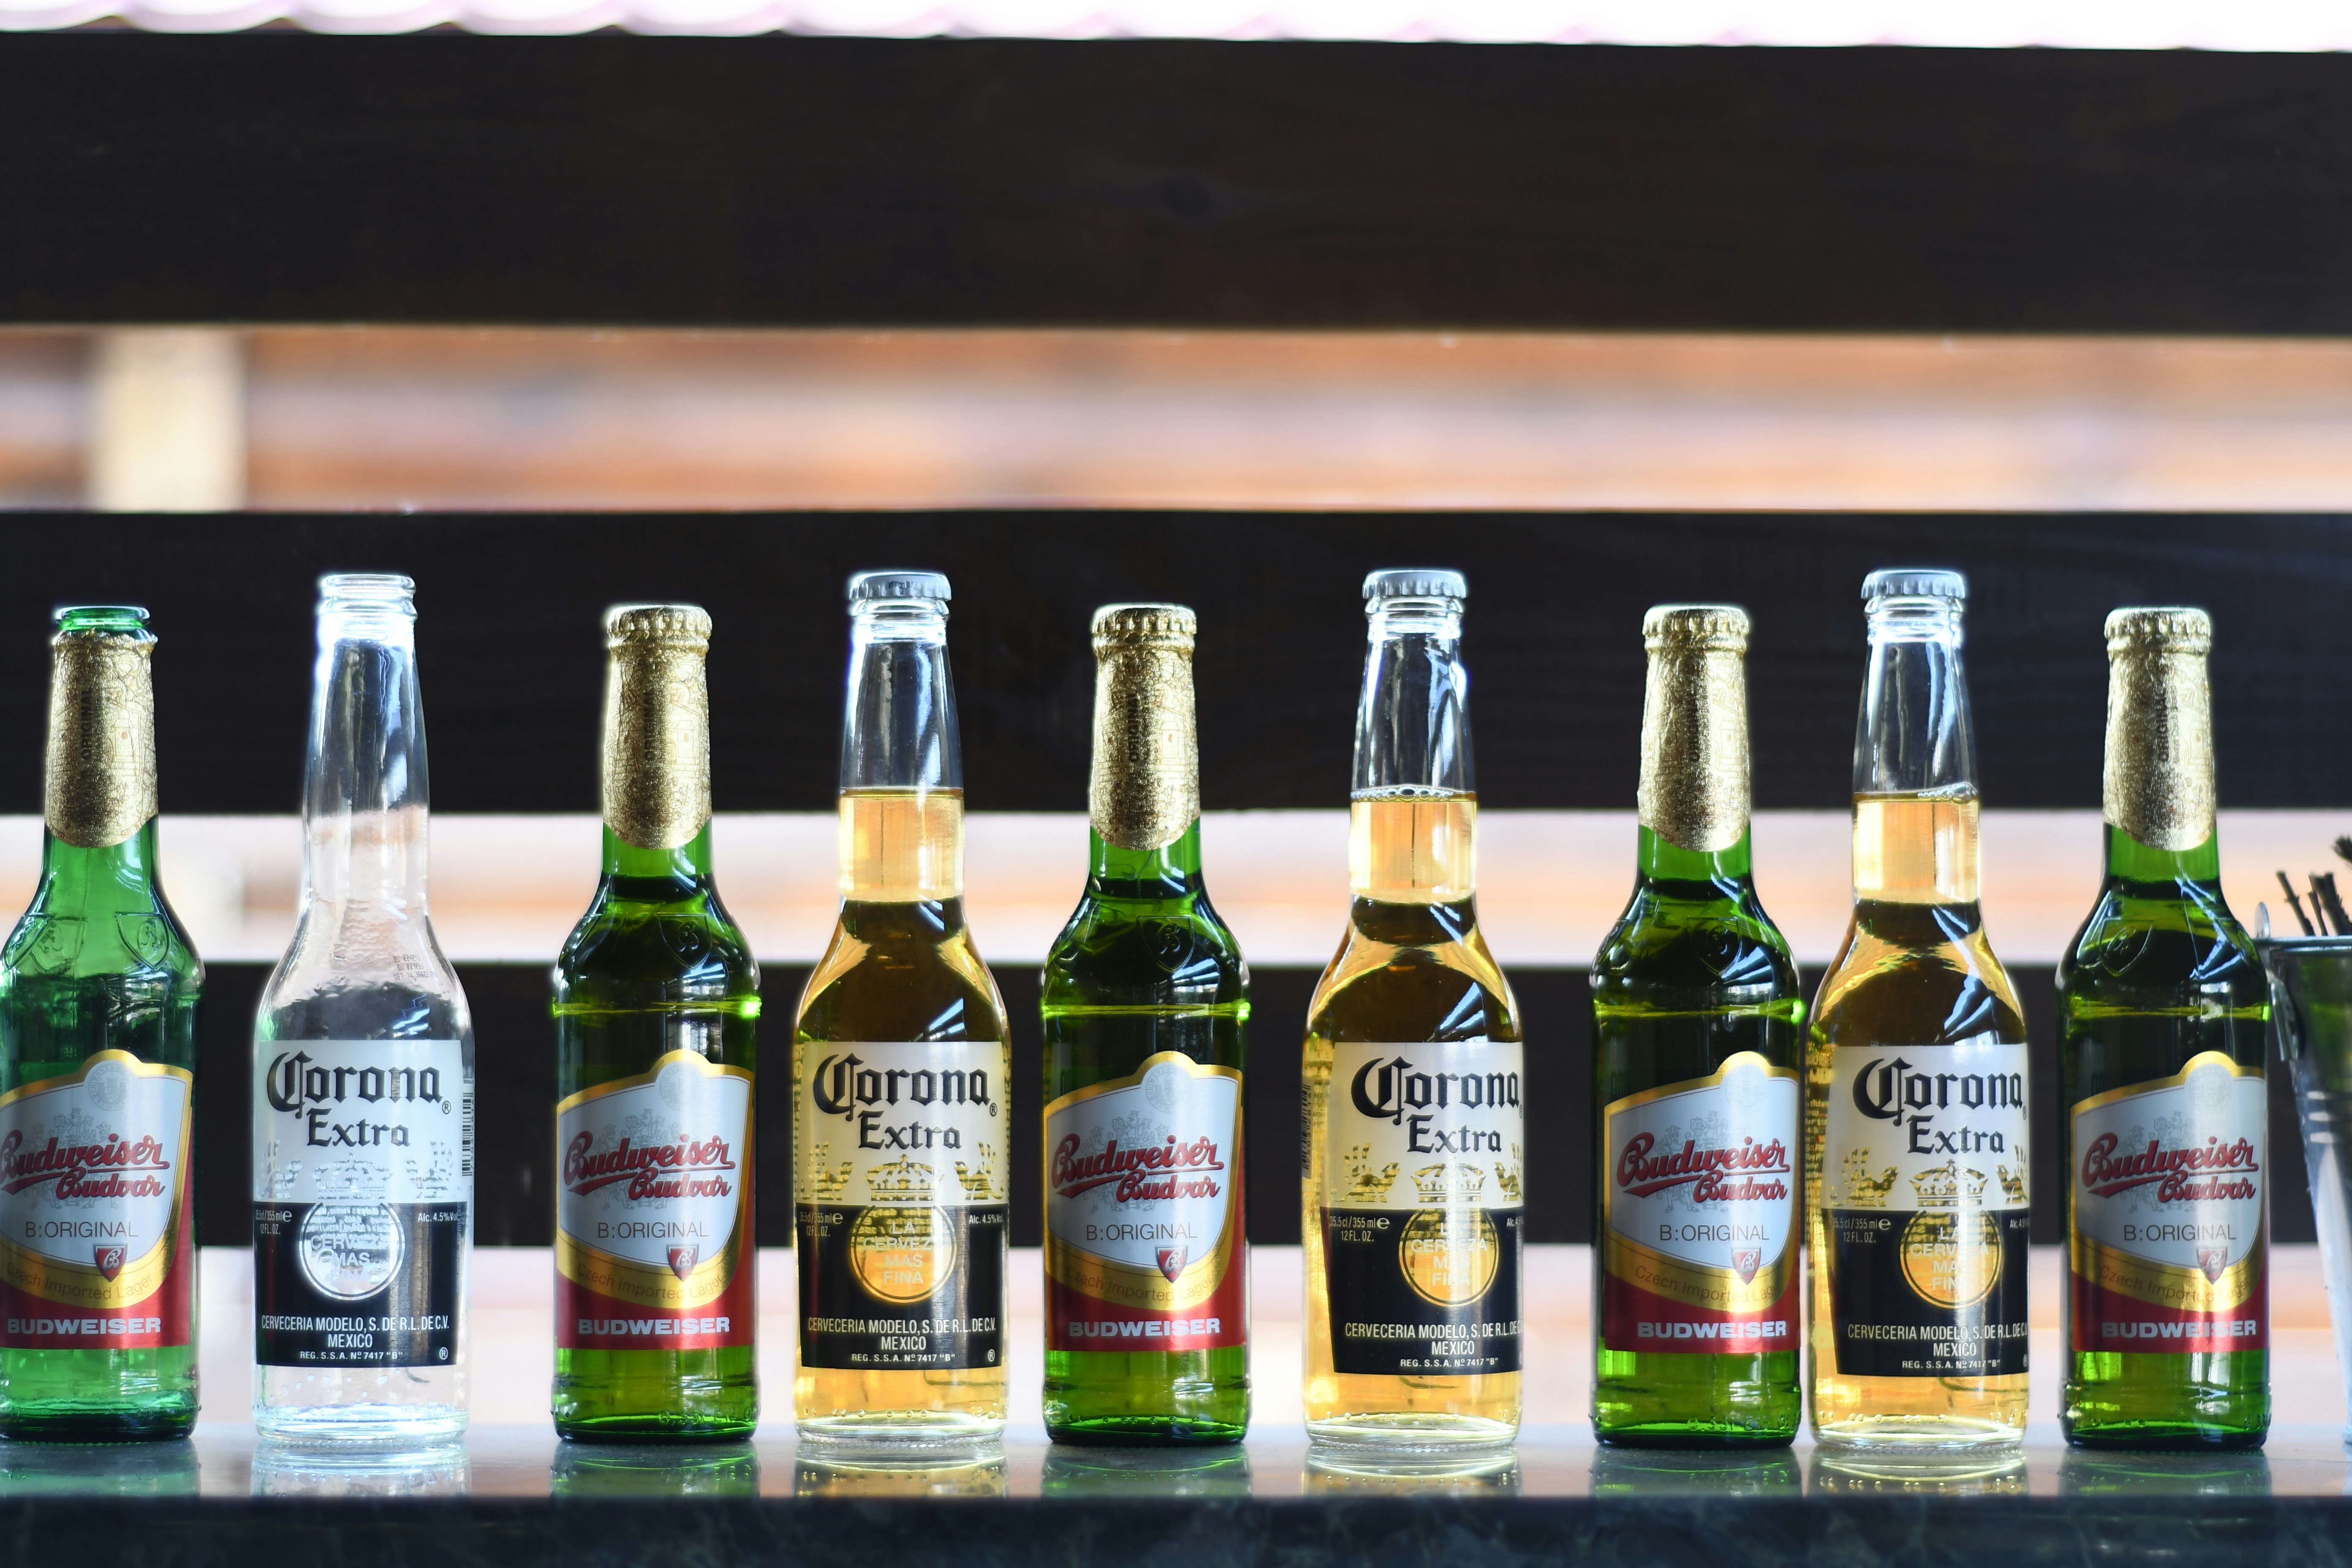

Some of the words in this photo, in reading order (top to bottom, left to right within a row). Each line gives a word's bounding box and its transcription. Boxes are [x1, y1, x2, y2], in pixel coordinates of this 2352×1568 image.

[82, 686, 92, 760] ORIGINAL
[267, 1051, 443, 1119] Corona
[813, 1053, 991, 1122] Corona
[1351, 1056, 1519, 1125] Corona
[1853, 1057, 2023, 1127] Corona
[307, 1108, 411, 1146] Extra
[858, 1111, 962, 1149] Extra
[1407, 1114, 1502, 1153] Extra
[1907, 1115, 2004, 1154] Extra
[0, 1130, 170, 1180] Budweiser
[564, 1130, 735, 1185] Budweiser
[1052, 1133, 1224, 1187] Budweiser
[1617, 1132, 1790, 1187] Budweiser
[2082, 1133, 2259, 1187] Budweiser
[56, 1168, 166, 1200] Budvar
[629, 1168, 732, 1198] Budvar
[1117, 1169, 1221, 1203] Budvar
[1694, 1170, 1788, 1203] Budvar
[2158, 1170, 2256, 1203] Budvar
[418, 1213, 432, 1222] Alc.
[969, 1215, 981, 1224] Alc.
[1507, 1218, 1515, 1227] Alc.
[272, 1224, 280, 1234] OZ.
[821, 1226, 830, 1237] OZ.
[893, 1222, 915, 1234] LA
[1362, 1230, 1374, 1241] OZ.
[863, 1237, 944, 1250] CERVEZ
[1411, 1239, 1486, 1252] CERVEZA
[1865, 1232, 1876, 1243] OZ.
[332, 1252, 370, 1265] MAS
[885, 1255, 923, 1267] MAS
[1434, 1256, 1469, 1269] MAS
[8, 1262, 41, 1286] Czech
[45, 1277, 112, 1299] Imported
[117, 1274, 152, 1298] Lager
[331, 1269, 370, 1282] FINA
[578, 1263, 614, 1287] Czech
[619, 1278, 683, 1299] Imported
[690, 1274, 722, 1298] Lager
[884, 1271, 923, 1284] FINA
[1433, 1273, 1470, 1285] FINA
[1636, 1266, 1677, 1291] Czech
[1682, 1281, 1748, 1302] Imported
[1753, 1282, 1778, 1301] Lage
[2100, 1266, 2142, 1290] Czech
[1108, 1280, 1173, 1301] Imported
[8, 1318, 161, 1335] BUDWEISER
[262, 1315, 313, 1331] CERVECERIA
[316, 1317, 367, 1333] MODELO,
[369, 1317, 380, 1331] S.
[382, 1317, 396, 1331] DE
[400, 1317, 419, 1330] R.L.
[422, 1316, 433, 1330] DE
[436, 1315, 449, 1329] C.V.
[579, 1317, 730, 1335] BUDWEISER
[808, 1317, 866, 1333] CERVECERIA
[868, 1320, 920, 1336] MODELO,
[922, 1320, 933, 1334] S.
[936, 1320, 950, 1333] DE
[953, 1319, 971, 1332] R.L.
[972, 1318, 983, 1331] DE
[985, 1318, 996, 1331] C.V.
[1070, 1319, 1220, 1337] BUDWEISER
[1345, 1323, 1415, 1338] CERVECERIA
[1419, 1324, 1469, 1340] MODELO,
[1471, 1324, 1480, 1338] S.
[1483, 1323, 1494, 1337] DE
[1496, 1323, 1509, 1336] R.L.
[1510, 1321, 1516, 1334] DE
[1637, 1321, 1786, 1338] BUDWEISER
[1848, 1324, 1917, 1339] CERVECERIA
[1920, 1326, 1971, 1342] MODELO,
[1973, 1326, 1982, 1339] S.
[1985, 1325, 1995, 1339] DE
[1998, 1324, 2012, 1338] R.L.
[2013, 1323, 2020, 1337] DE
[2102, 1320, 2256, 1338] BUDWEISER
[328, 1334, 373, 1348] MEXICO
[881, 1336, 926, 1350] MEXICO
[1432, 1340, 1475, 1355] MEXICO
[1933, 1342, 1976, 1356] MEXICO
[1424, 1359, 1452, 1367] S.S.A.
[1926, 1361, 1953, 1369] S.S.A.
